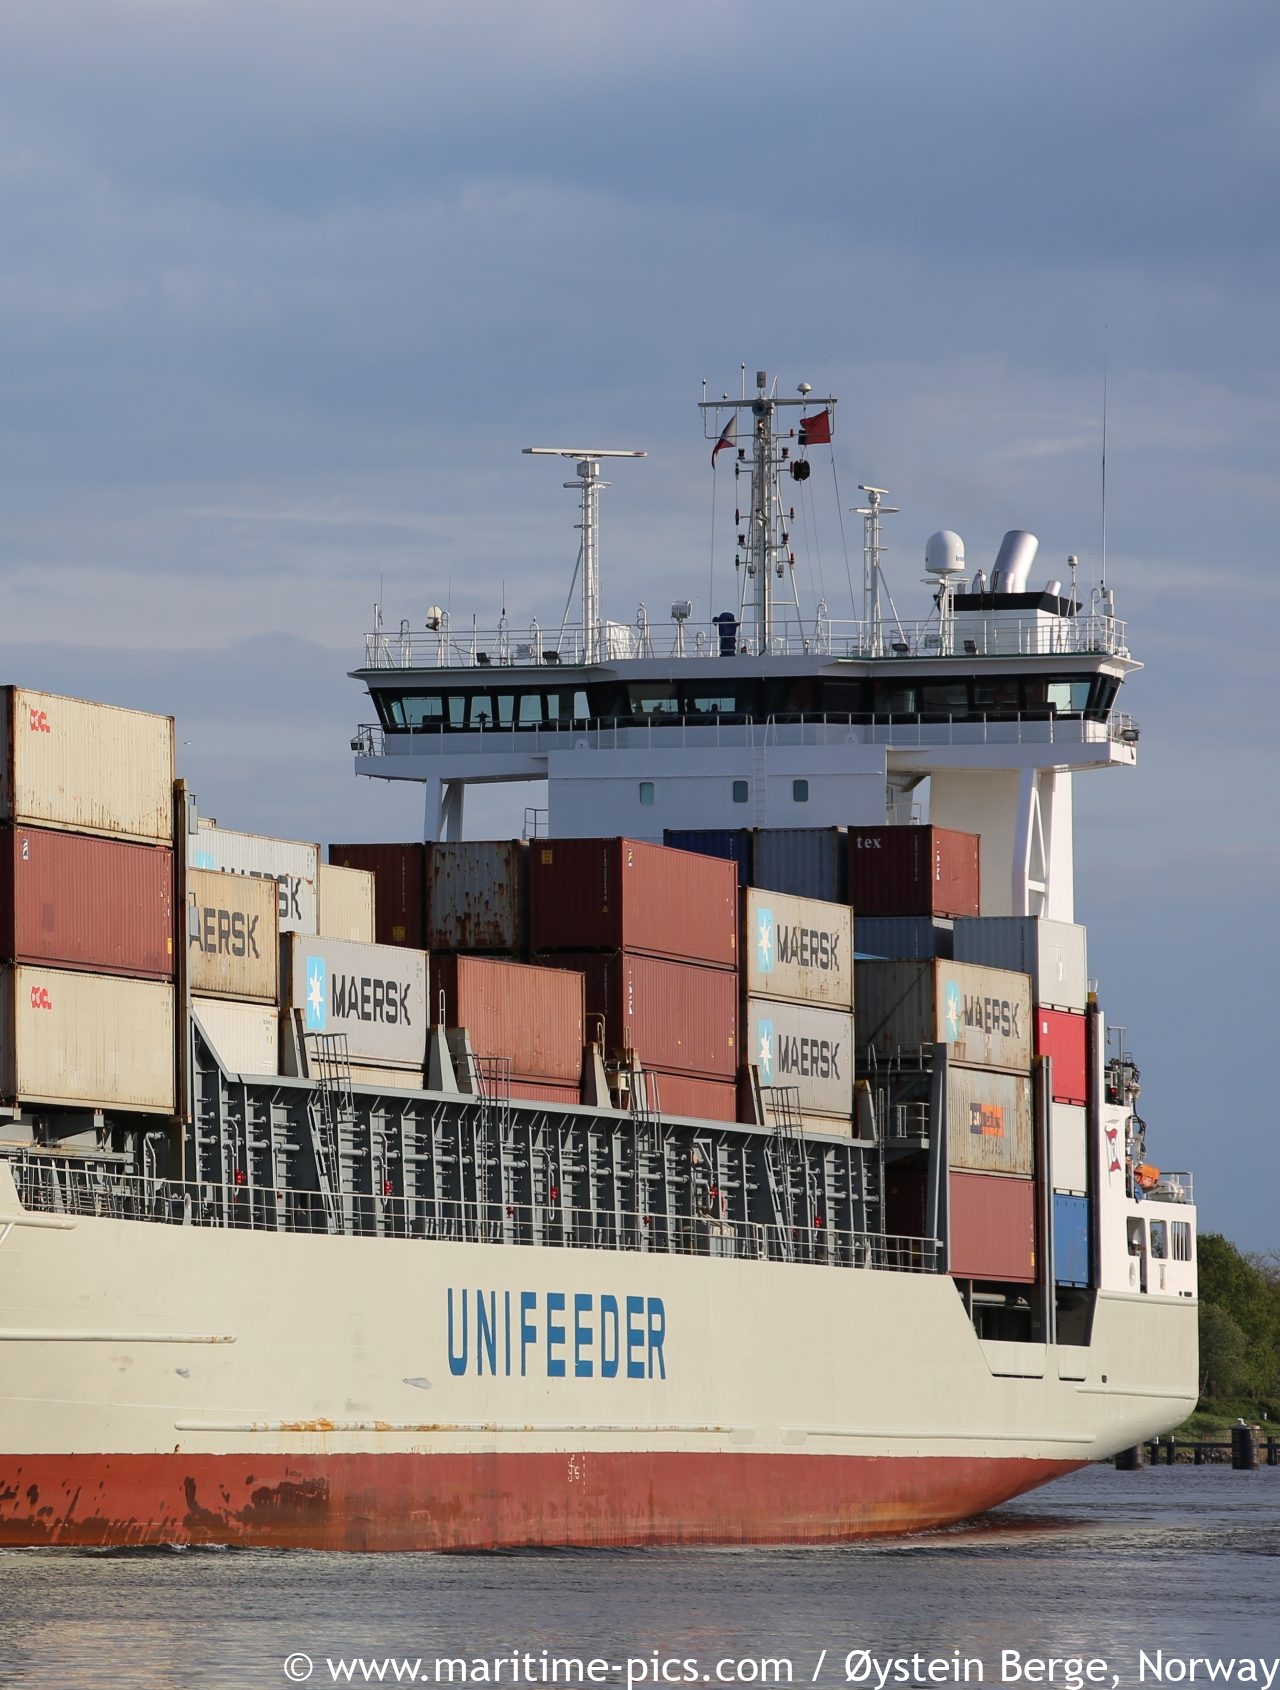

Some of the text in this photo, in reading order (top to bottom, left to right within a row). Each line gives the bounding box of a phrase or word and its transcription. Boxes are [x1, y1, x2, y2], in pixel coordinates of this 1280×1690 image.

[857, 836, 882, 849] tex
[777, 924, 840, 972] MAERSK
[332, 973, 411, 1026] MAERSK
[964, 994, 1020, 1040] MAERSK
[778, 1034, 840, 1081] MAERSK
[447, 1287, 666, 1380] UNIFEEDER
